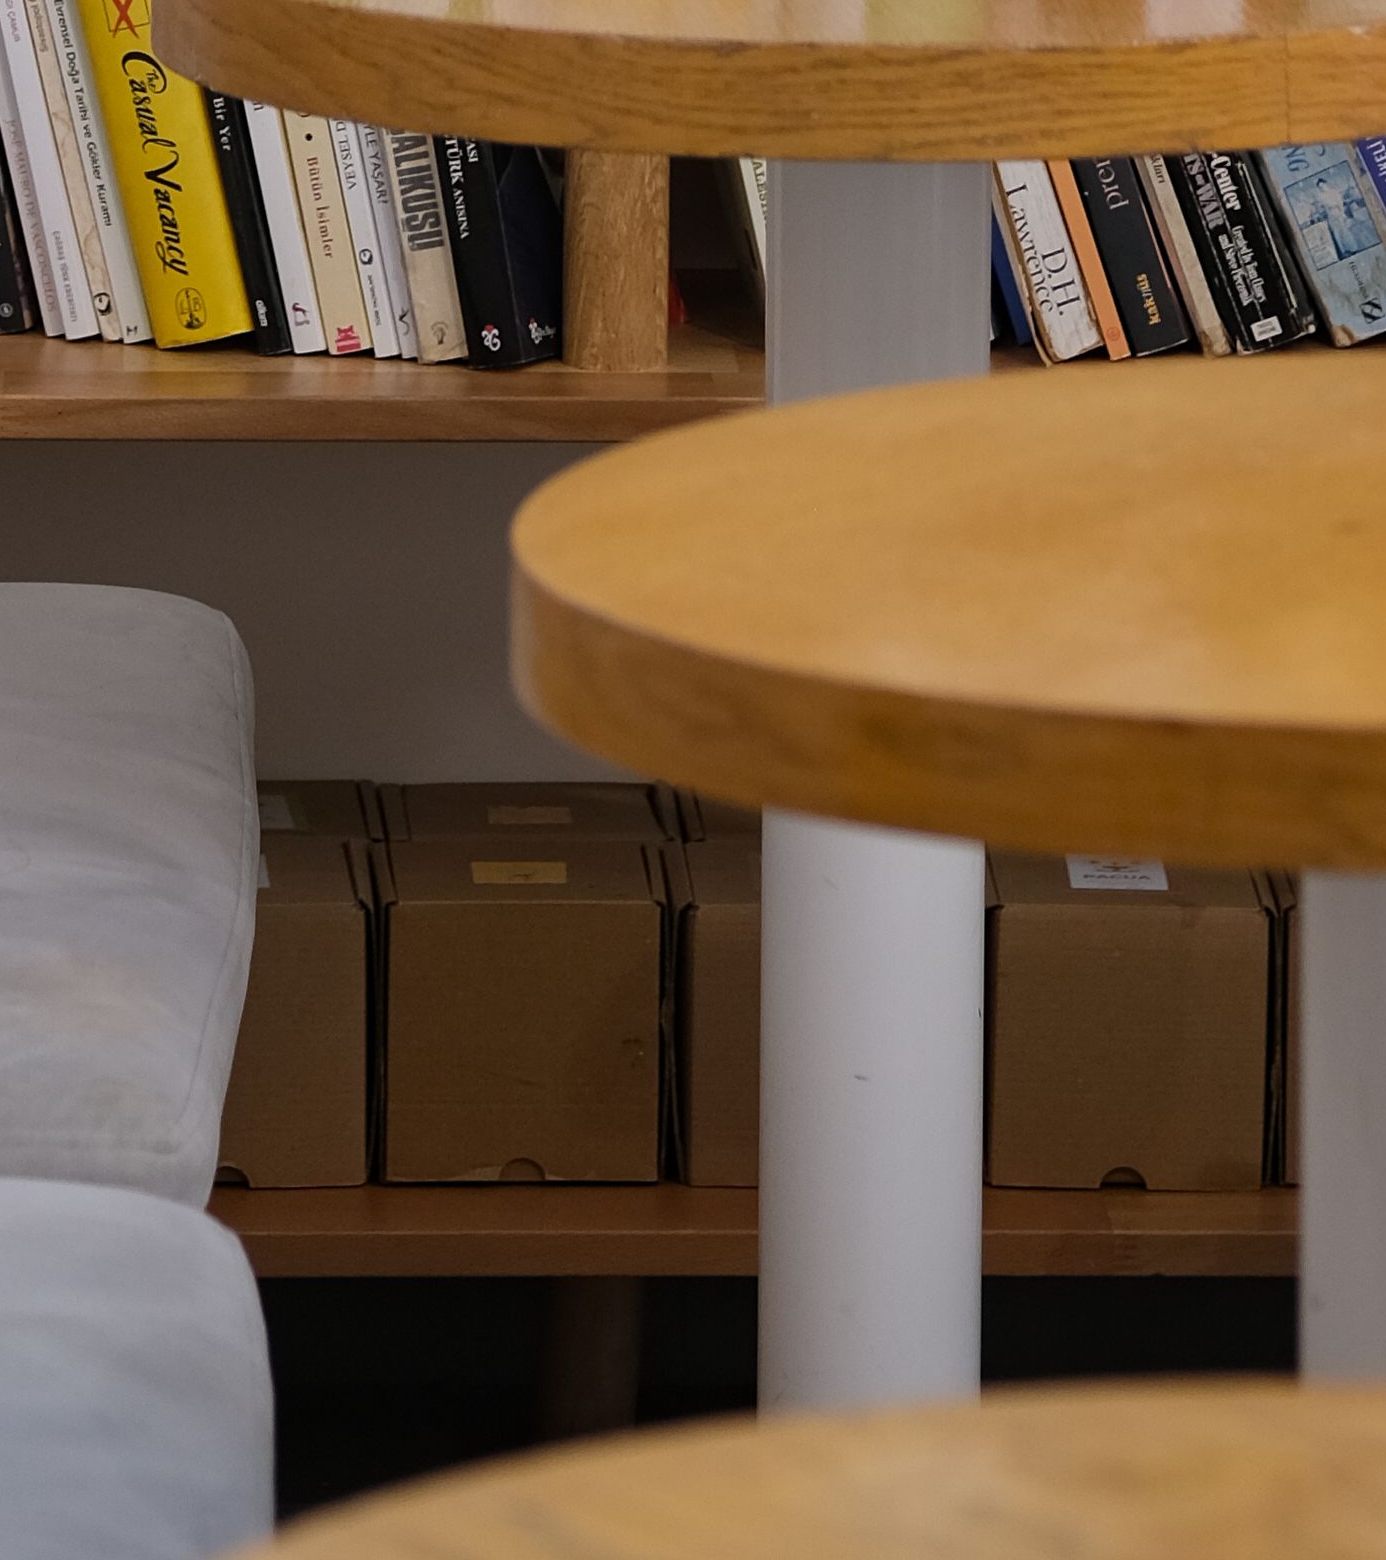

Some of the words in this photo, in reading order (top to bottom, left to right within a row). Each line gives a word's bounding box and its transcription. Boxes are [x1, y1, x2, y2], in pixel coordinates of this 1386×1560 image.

[121, 50, 167, 155] Casual
[212, 96, 225, 123] Bir
[217, 125, 232, 152] Yer
[338, 134, 358, 190] VEYSEL
[143, 143, 190, 276] Vacancy
[1006, 182, 1054, 313] Lawrence
[1041, 247, 1081, 317] D.H.
